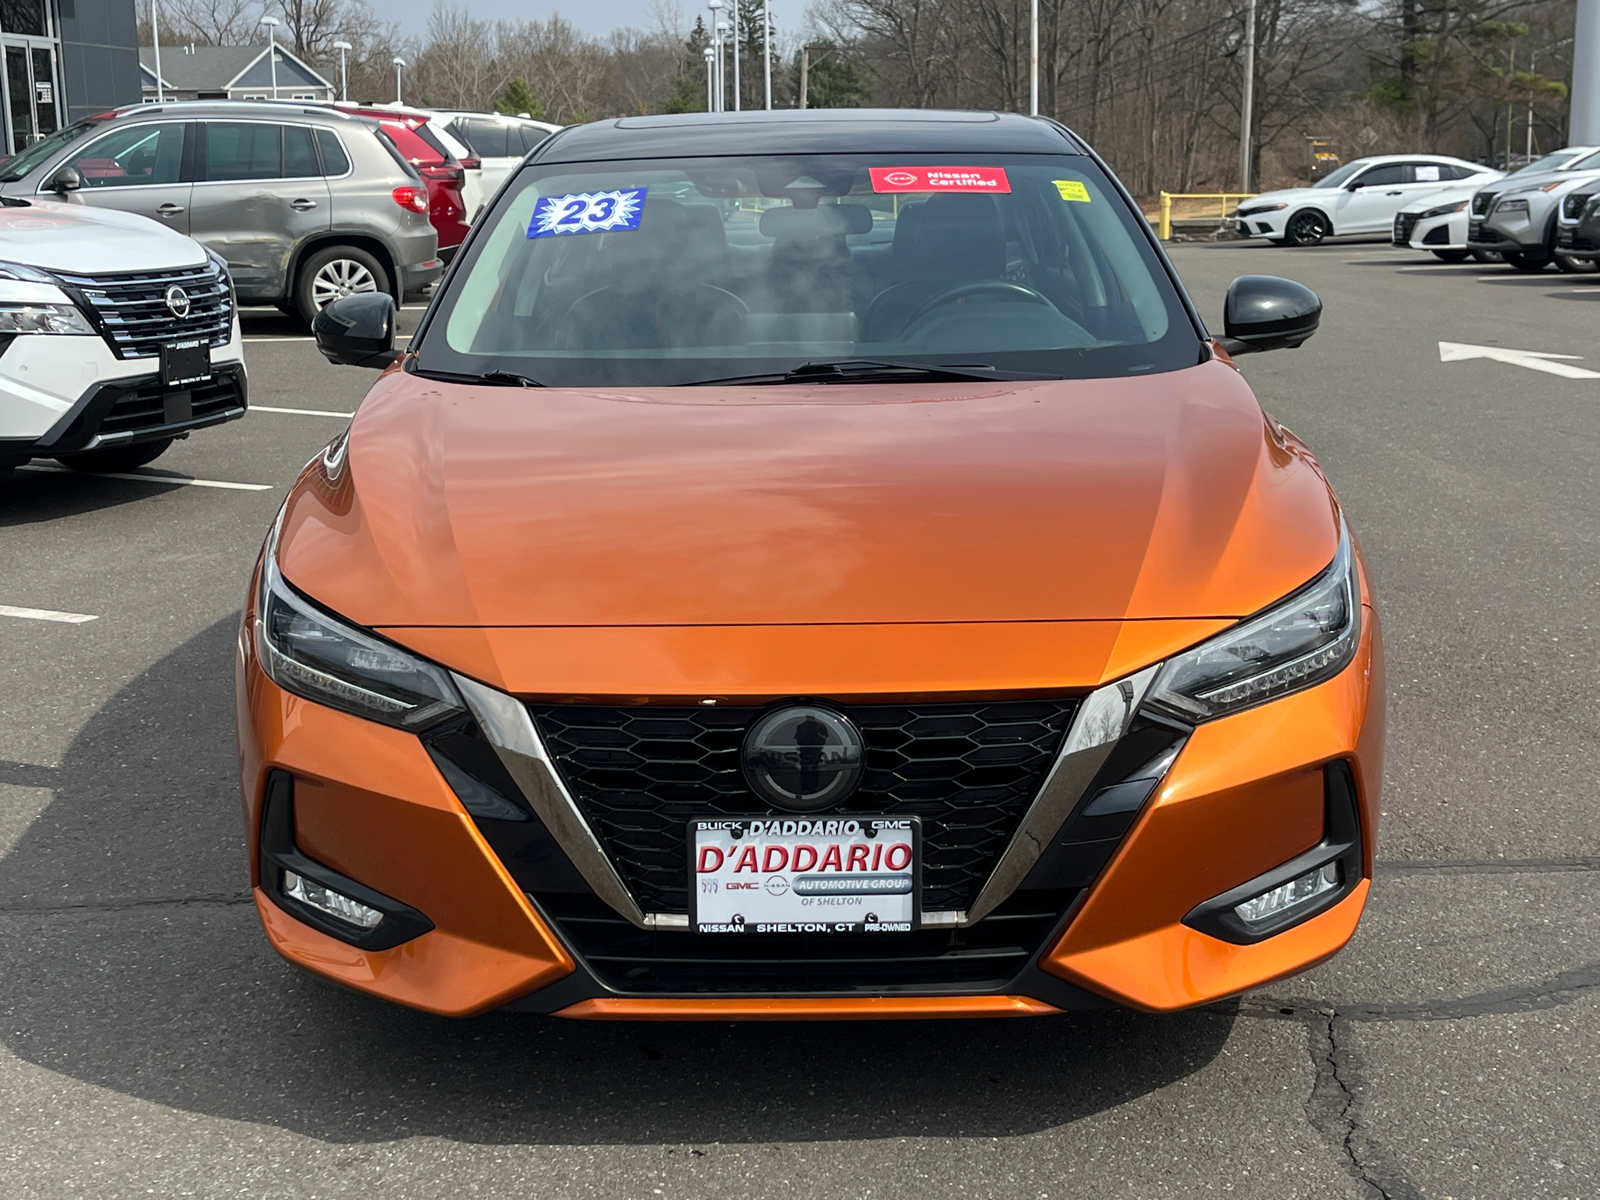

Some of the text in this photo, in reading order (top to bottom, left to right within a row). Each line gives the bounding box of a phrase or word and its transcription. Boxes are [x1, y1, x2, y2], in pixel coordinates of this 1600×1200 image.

[929, 179, 997, 187] Certified
[556, 197, 618, 226] 23
[697, 822, 743, 830] BUICK
[749, 820, 860, 837] D'ADDARIO
[871, 820, 911, 829] GMC
[696, 842, 913, 874] D'ADDARIO
[726, 882, 760, 890] GMC
[799, 879, 909, 890] AUTOMOTIVE GROUP
[801, 897, 863, 906] OF SHELTON
[699, 925, 745, 933] NISSAN
[756, 923, 856, 933] SHELTON, CT
[864, 923, 911, 932] PRE-OWNED
